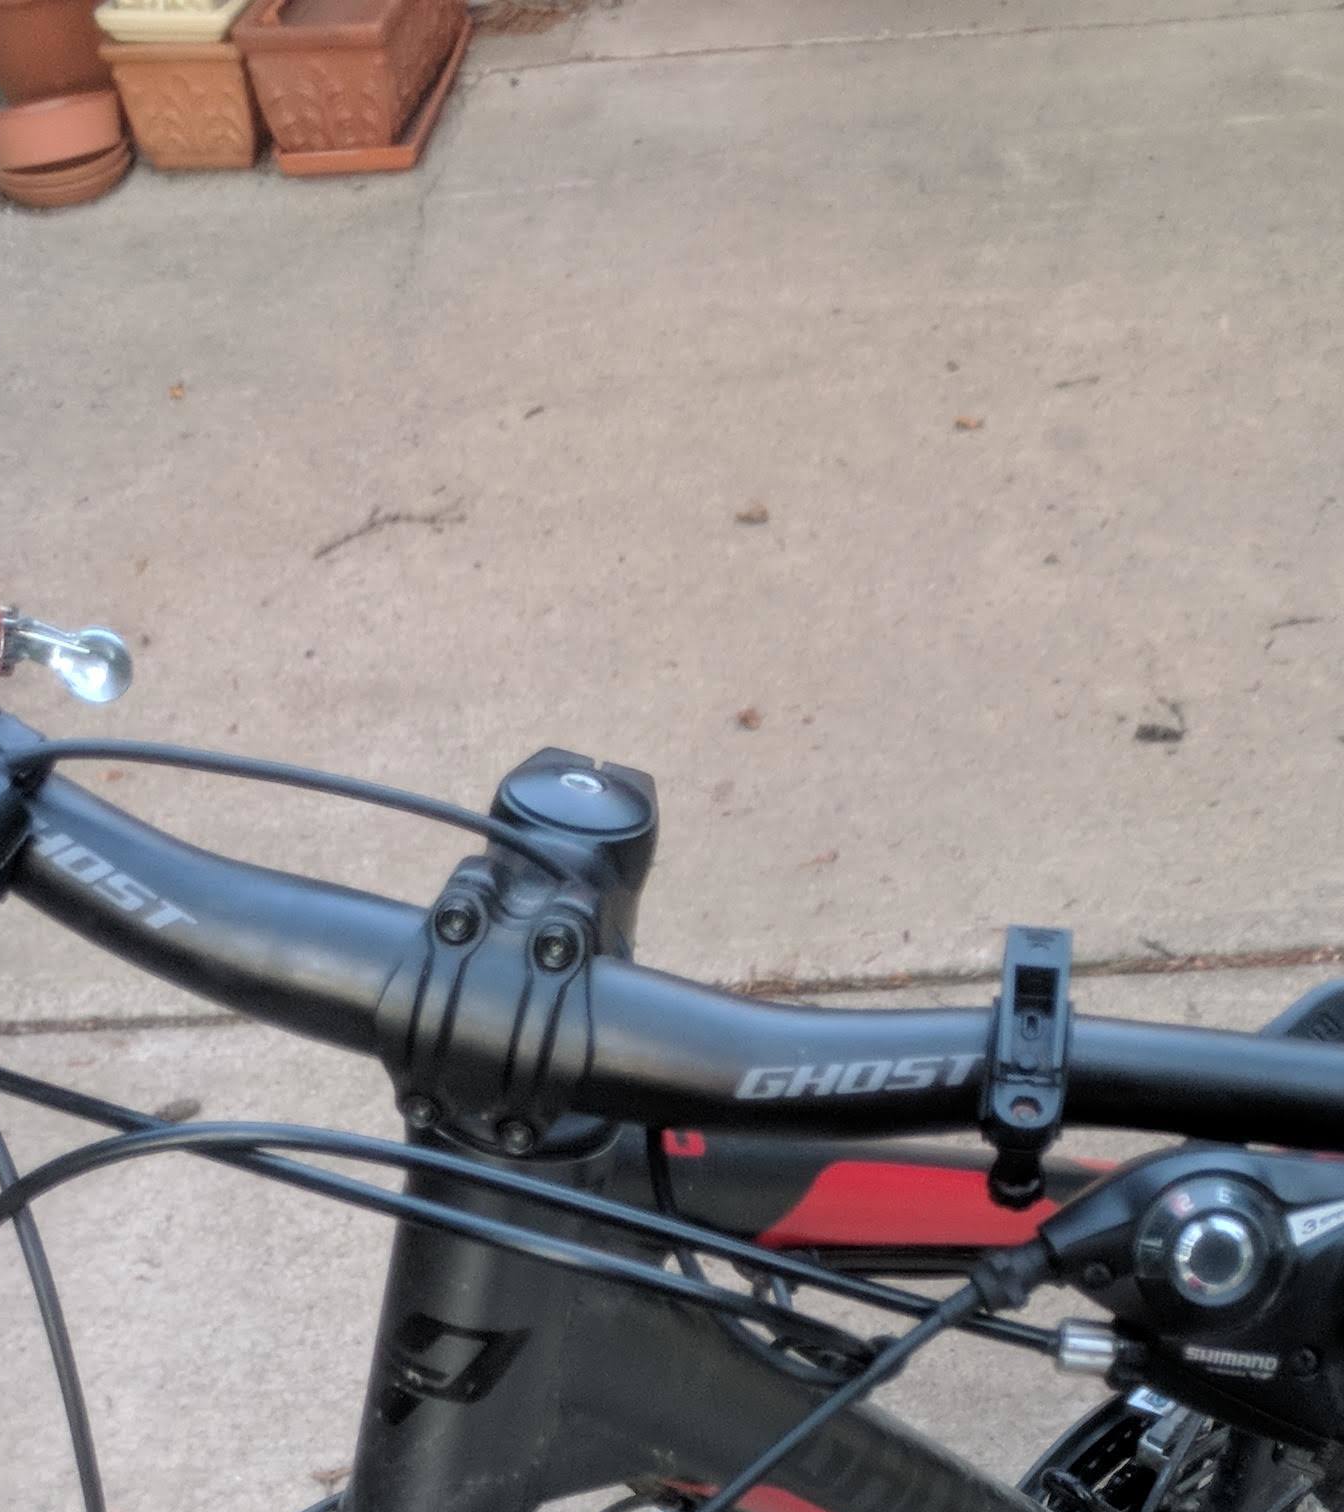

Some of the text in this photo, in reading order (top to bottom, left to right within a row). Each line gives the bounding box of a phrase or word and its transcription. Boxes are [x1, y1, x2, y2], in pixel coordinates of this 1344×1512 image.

[31, 812, 198, 930] HOST
[734, 1052, 987, 1101] GHOST
[1183, 1345, 1279, 1372] SHIMANO
